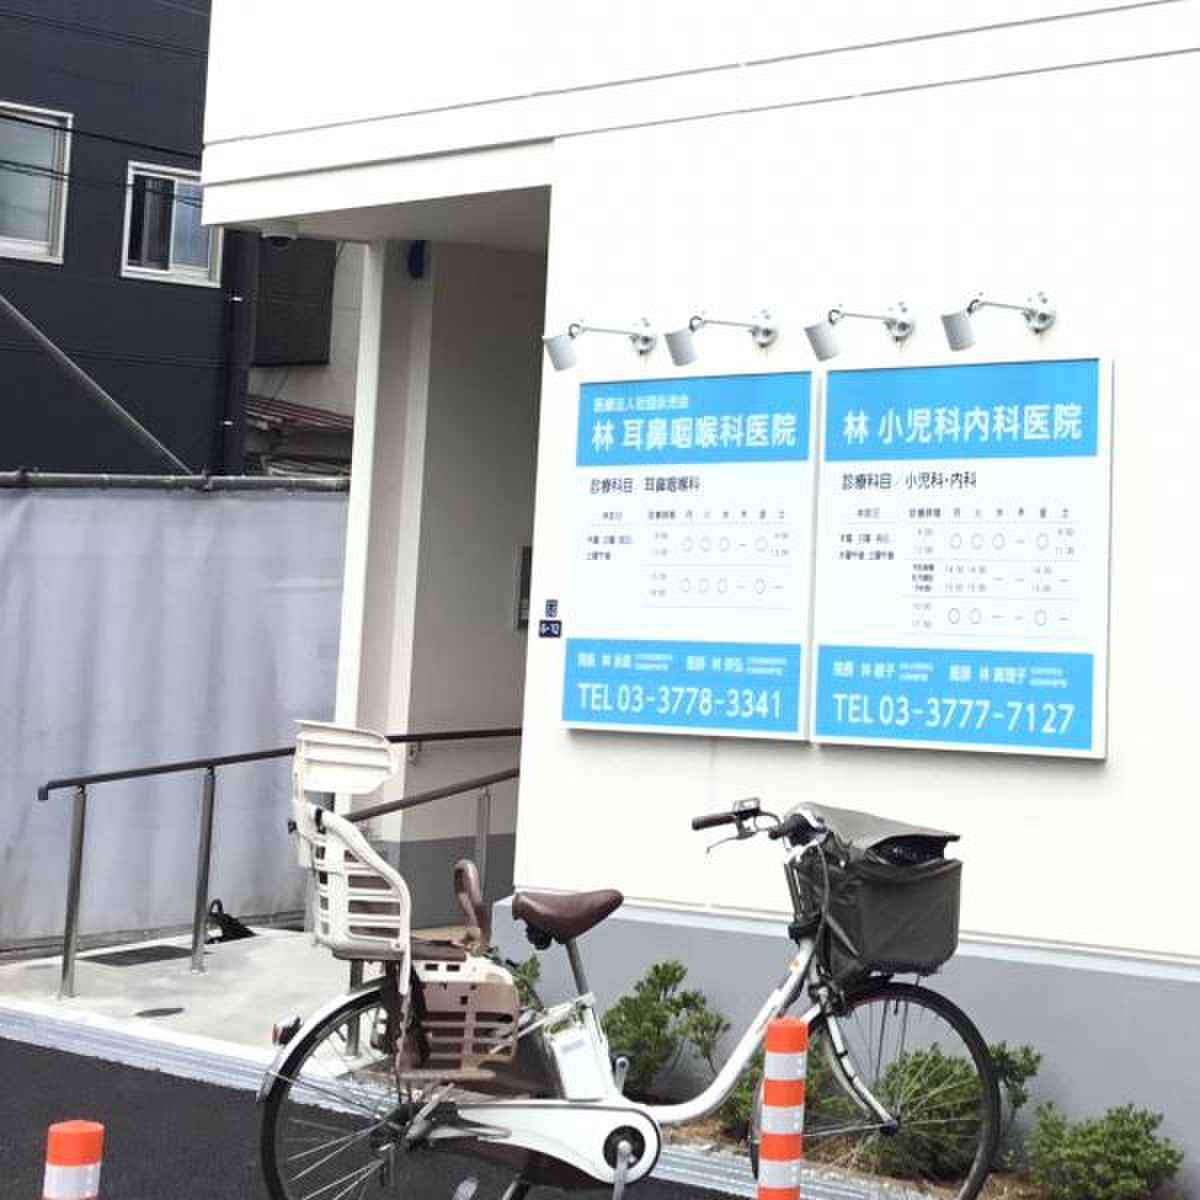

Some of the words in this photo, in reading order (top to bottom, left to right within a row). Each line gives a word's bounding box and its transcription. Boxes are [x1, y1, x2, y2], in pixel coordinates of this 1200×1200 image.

[591, 418, 615, 453] 林
[621, 412, 798, 451] 耳鼻咽喉科医院
[842, 409, 870, 445] 林
[878, 402, 1083, 444] 小児科内科医院
[576, 682, 614, 712] TEL
[617, 684, 781, 719] 03-3778-3341
[832, 692, 874, 725] TEL
[878, 694, 1076, 735] 03-3777-7127
